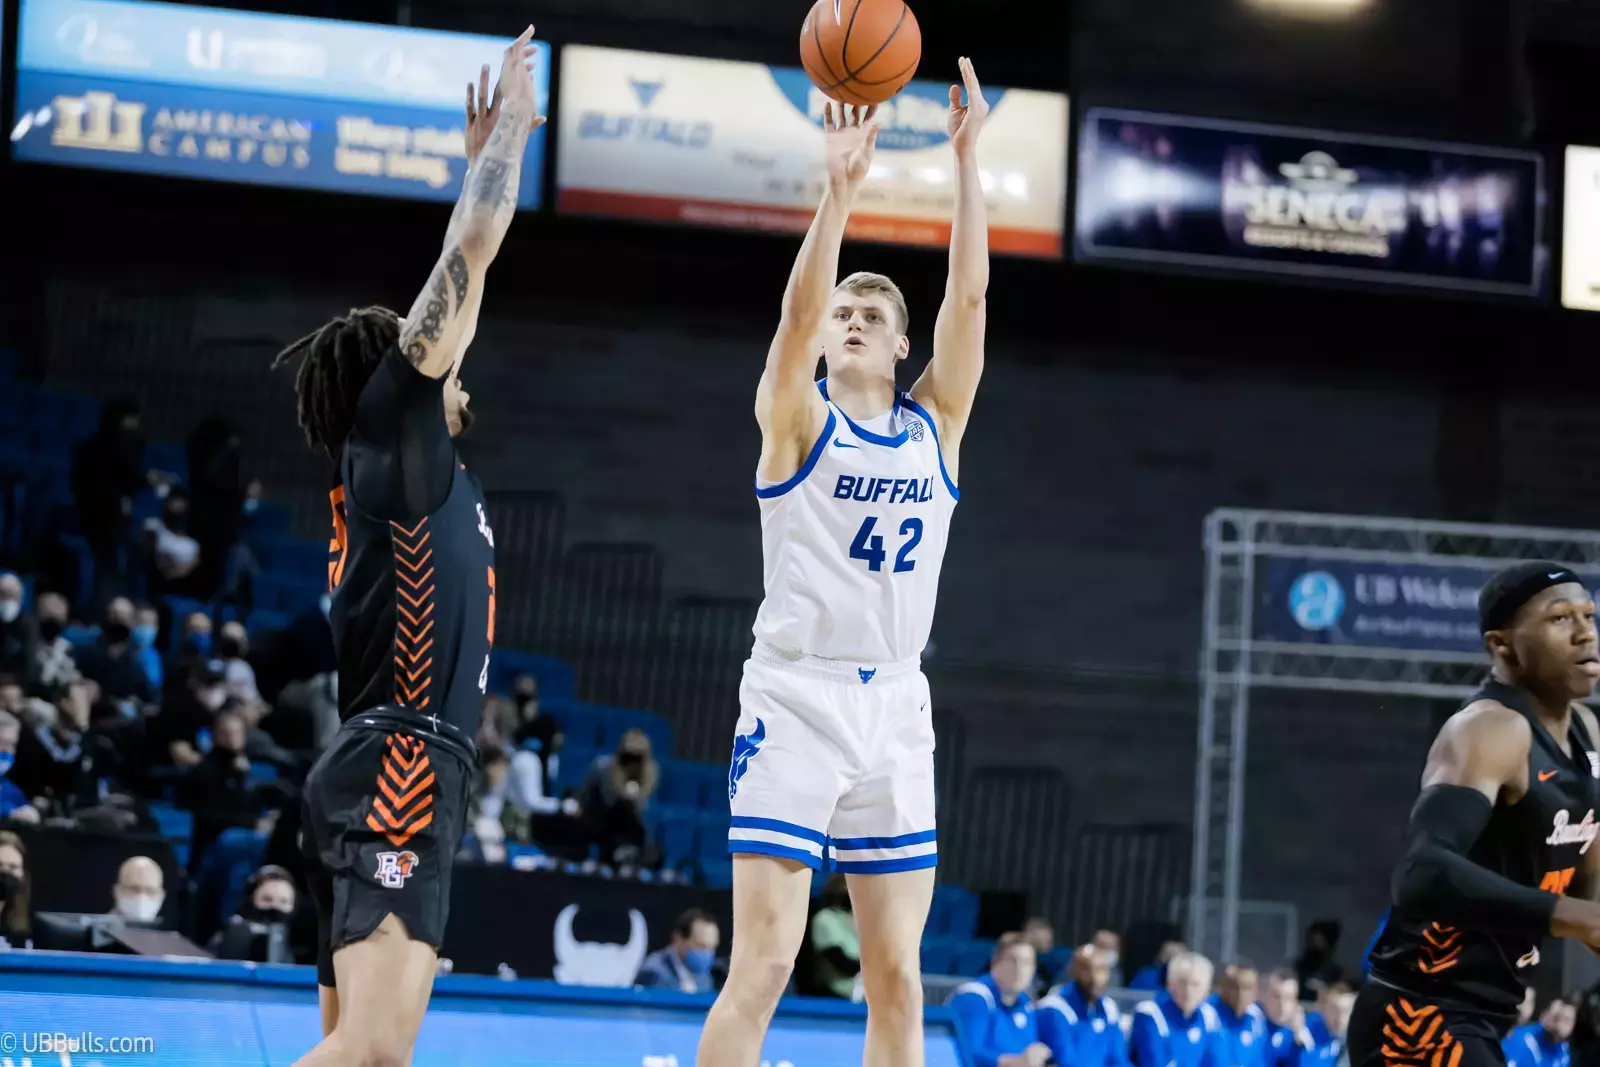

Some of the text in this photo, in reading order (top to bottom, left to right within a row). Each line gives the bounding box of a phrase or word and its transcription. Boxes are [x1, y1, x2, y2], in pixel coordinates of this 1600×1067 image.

[153, 107, 312, 142] AMERICAN
[580, 113, 713, 148] BUFFALO
[148, 131, 311, 168] CAMPUS
[1244, 184, 1388, 234] SENECA
[833, 475, 934, 503] BUFFAL
[849, 516, 923, 573] 42
